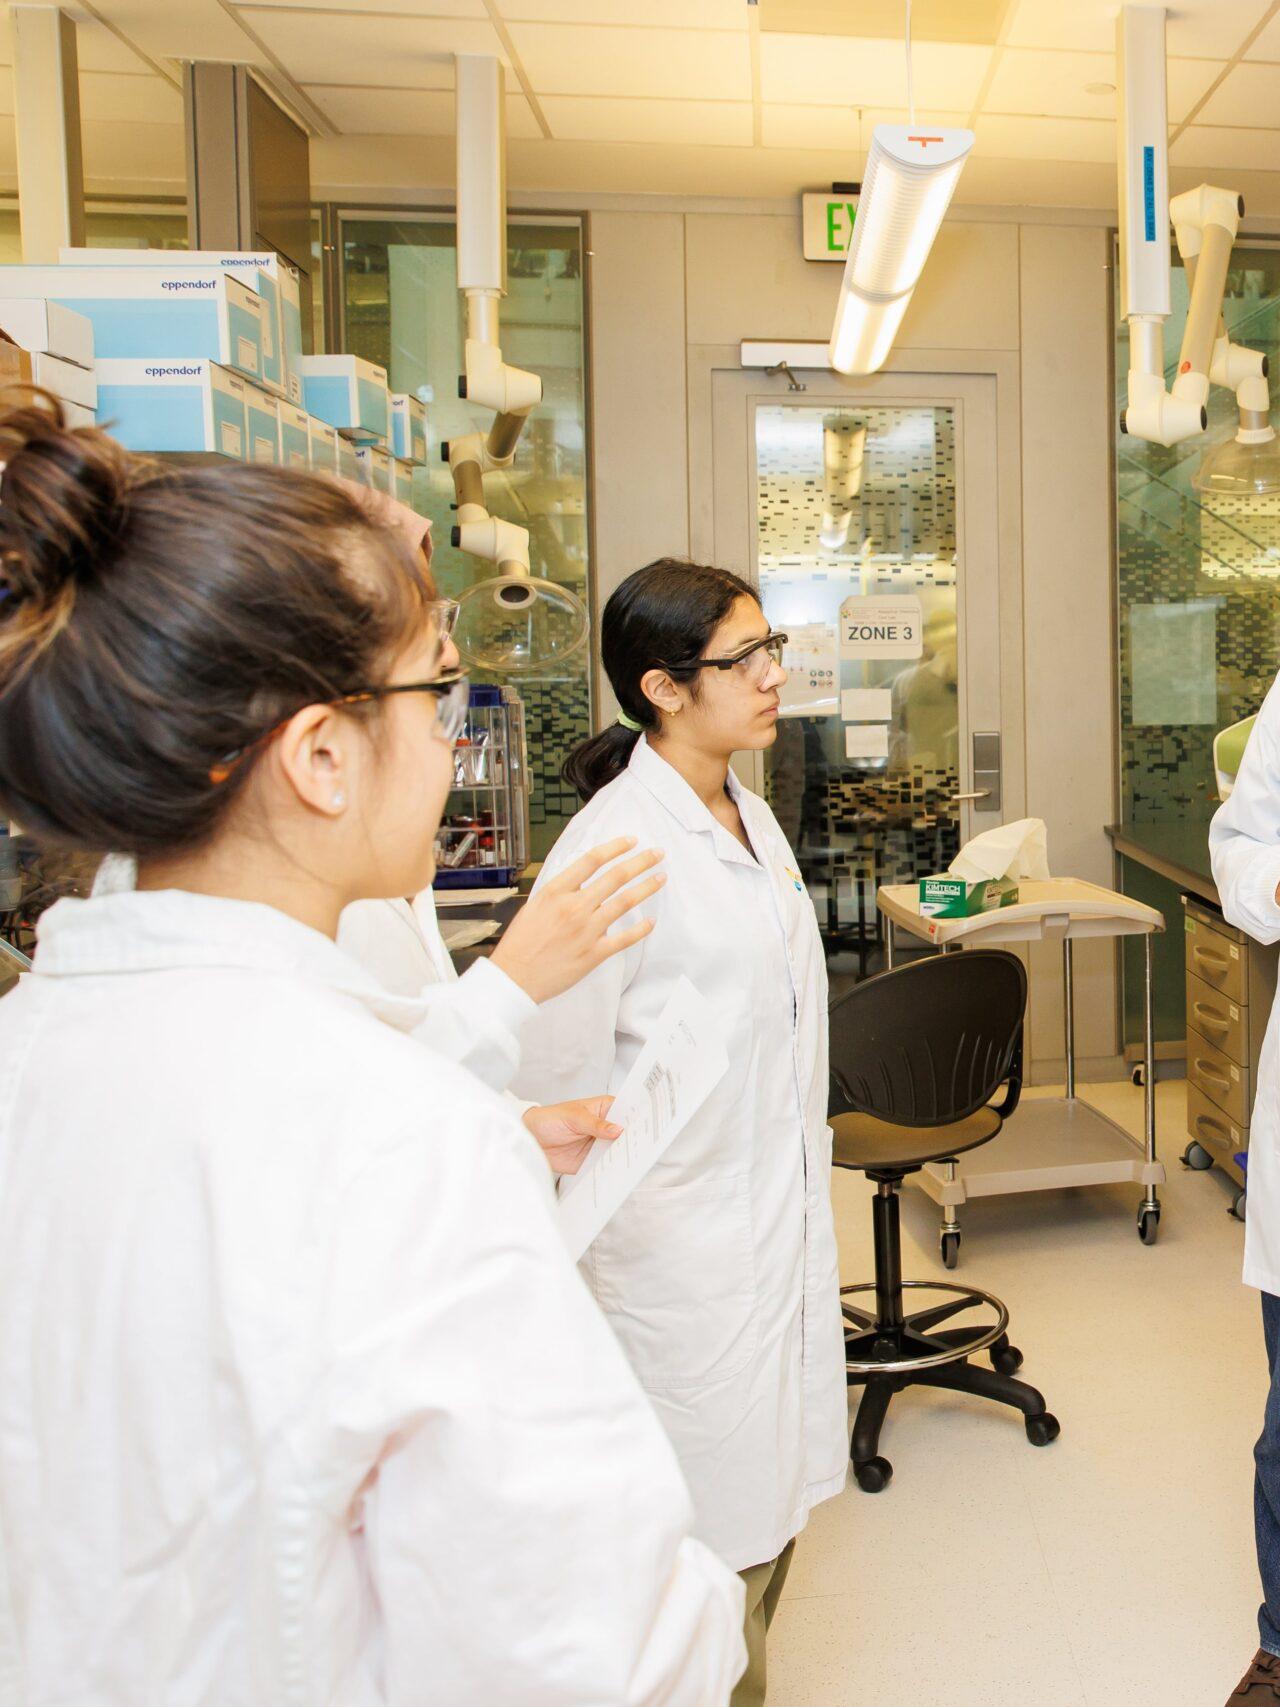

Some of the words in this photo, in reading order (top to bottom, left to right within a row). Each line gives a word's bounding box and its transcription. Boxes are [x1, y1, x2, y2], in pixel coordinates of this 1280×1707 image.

[161, 280, 217, 291] eppendorf
[145, 366, 202, 377] eppendorf
[848, 626, 897, 640] ZONE
[903, 626, 912, 640] 3
[926, 883, 960, 893] KIMTECH
